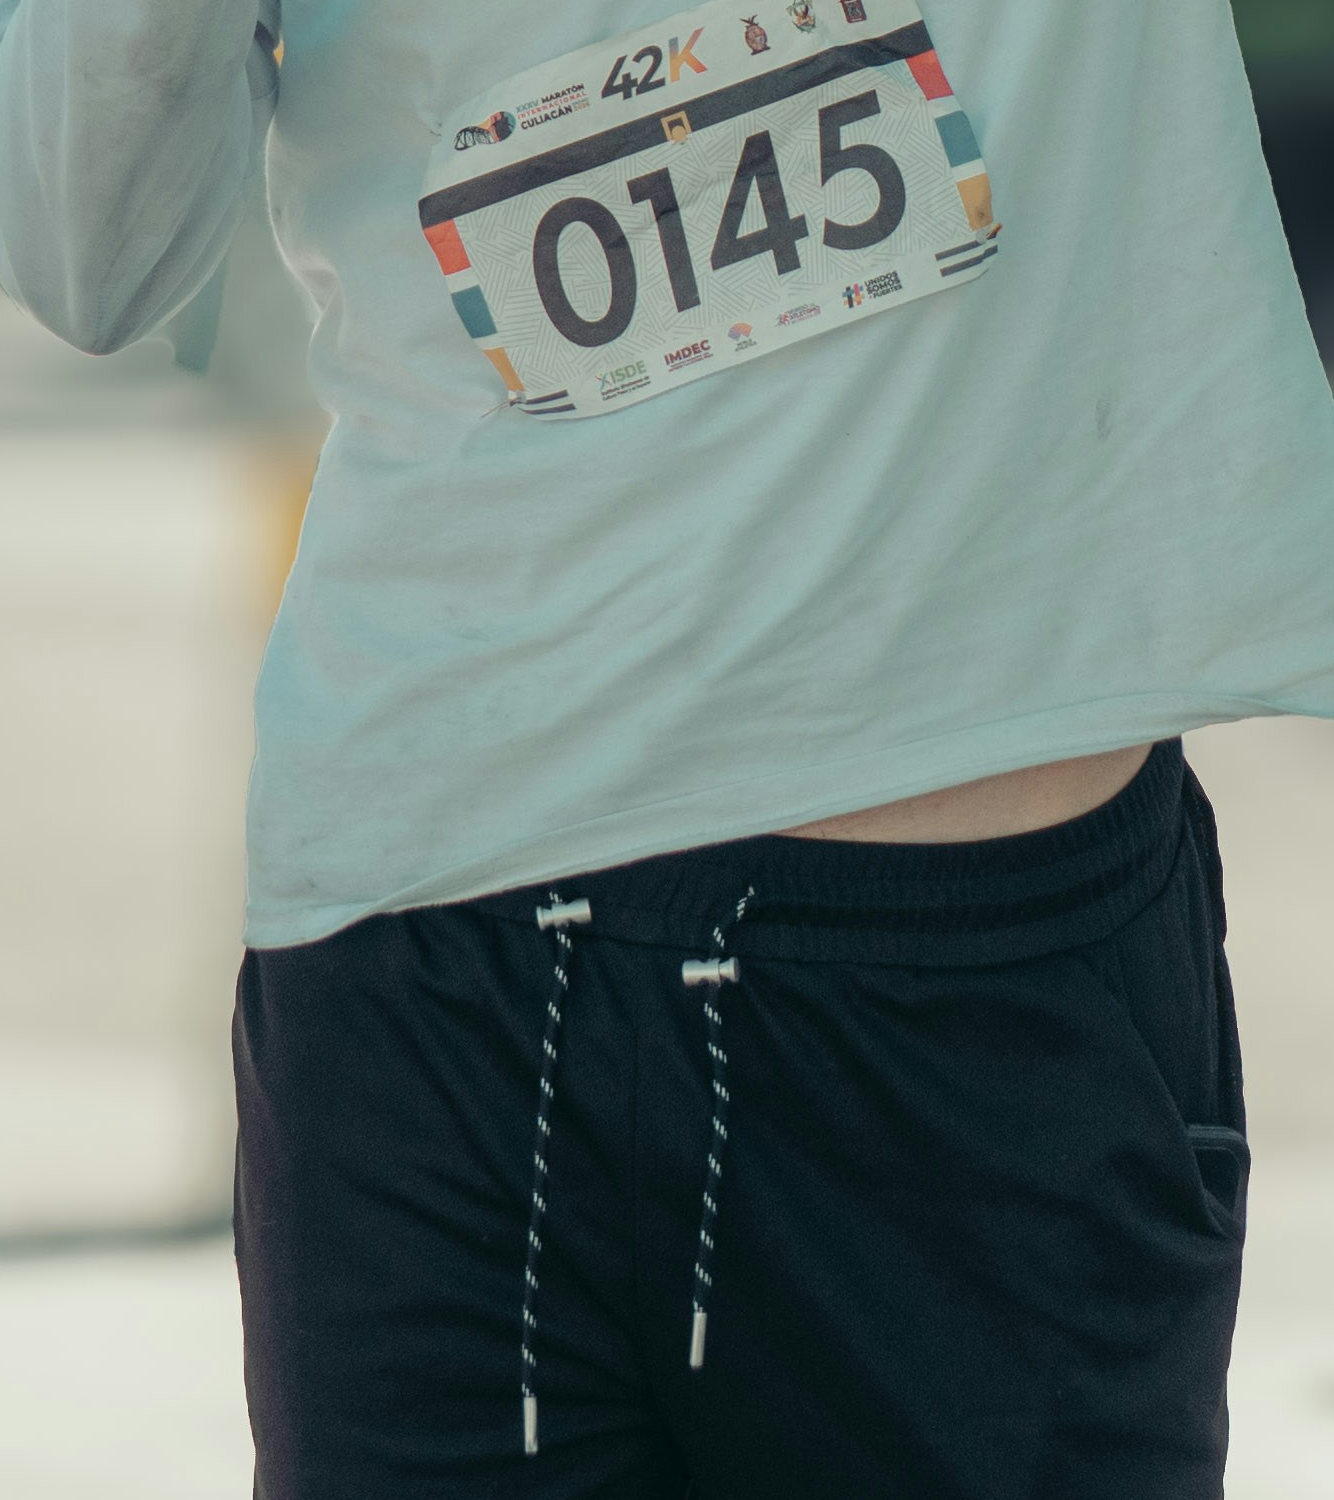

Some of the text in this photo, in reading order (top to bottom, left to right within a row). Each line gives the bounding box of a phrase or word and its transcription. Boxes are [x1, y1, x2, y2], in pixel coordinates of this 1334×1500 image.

[601, 26, 708, 101] 42K
[517, 91, 588, 120] INTERNACIONAL
[540, 83, 585, 104] MARATÓN
[520, 104, 573, 131] CULIACÁN
[533, 88, 907, 348] 0145
[864, 270, 899, 287] UNIDOS
[866, 277, 901, 294] SOMOS
[663, 339, 712, 366] IMDEC
[609, 360, 647, 385] ISDE
